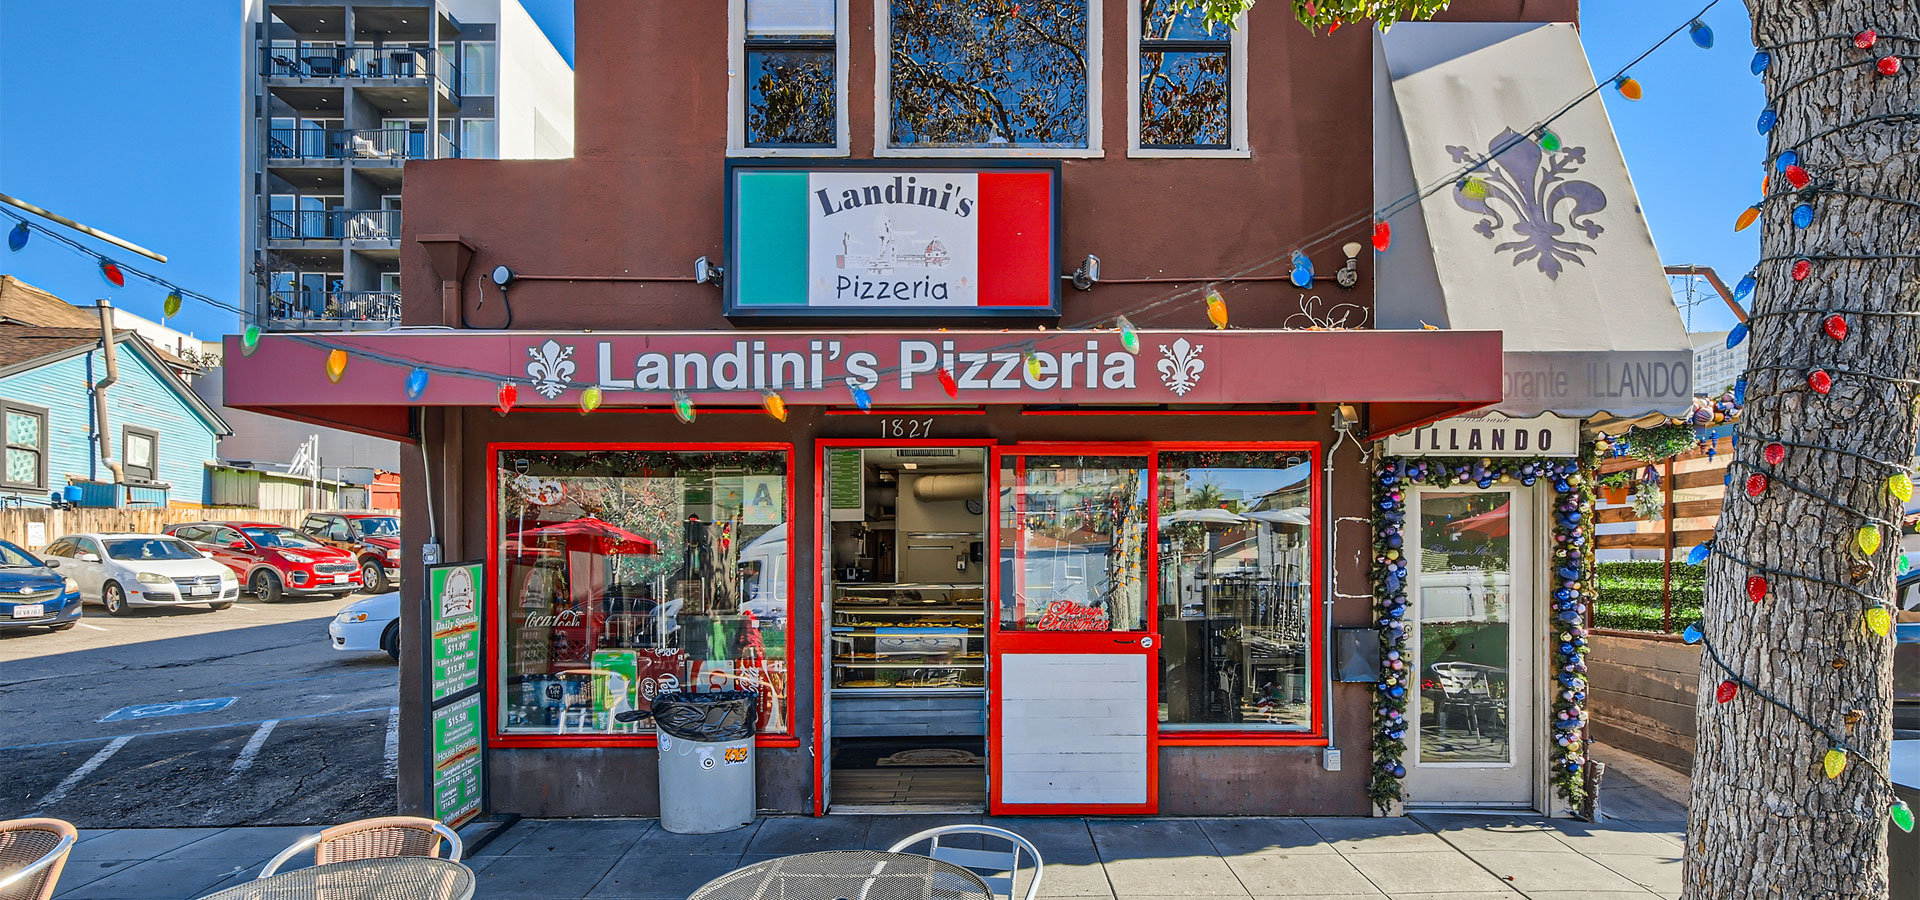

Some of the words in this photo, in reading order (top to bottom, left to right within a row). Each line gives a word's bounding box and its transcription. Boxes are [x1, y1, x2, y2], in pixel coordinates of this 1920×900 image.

[815, 176, 974, 218] Landini's
[836, 275, 948, 300] Pizzeria
[598, 341, 878, 390] Landini's
[901, 341, 1136, 390] Pizzeria
[1503, 365, 1568, 398] orante
[1587, 361, 1689, 398] ILLANDO
[880, 418, 933, 438] 1827
[1414, 428, 1552, 451] ILLANDO
[752, 483, 773, 506] A
[1049, 600, 1102, 620] Merry
[436, 620, 453, 631] Daily
[455, 614, 478, 628] Specials
[1038, 613, 1110, 632] Christmas
[447, 641, 466, 654] $11.99
[447, 662, 465, 675] $13.99
[448, 712, 467, 727] $15.50
[437, 748, 455, 761] House
[455, 737, 477, 753] Favorites
[443, 811, 460, 824] Deliver
[460, 802, 470, 814] and
